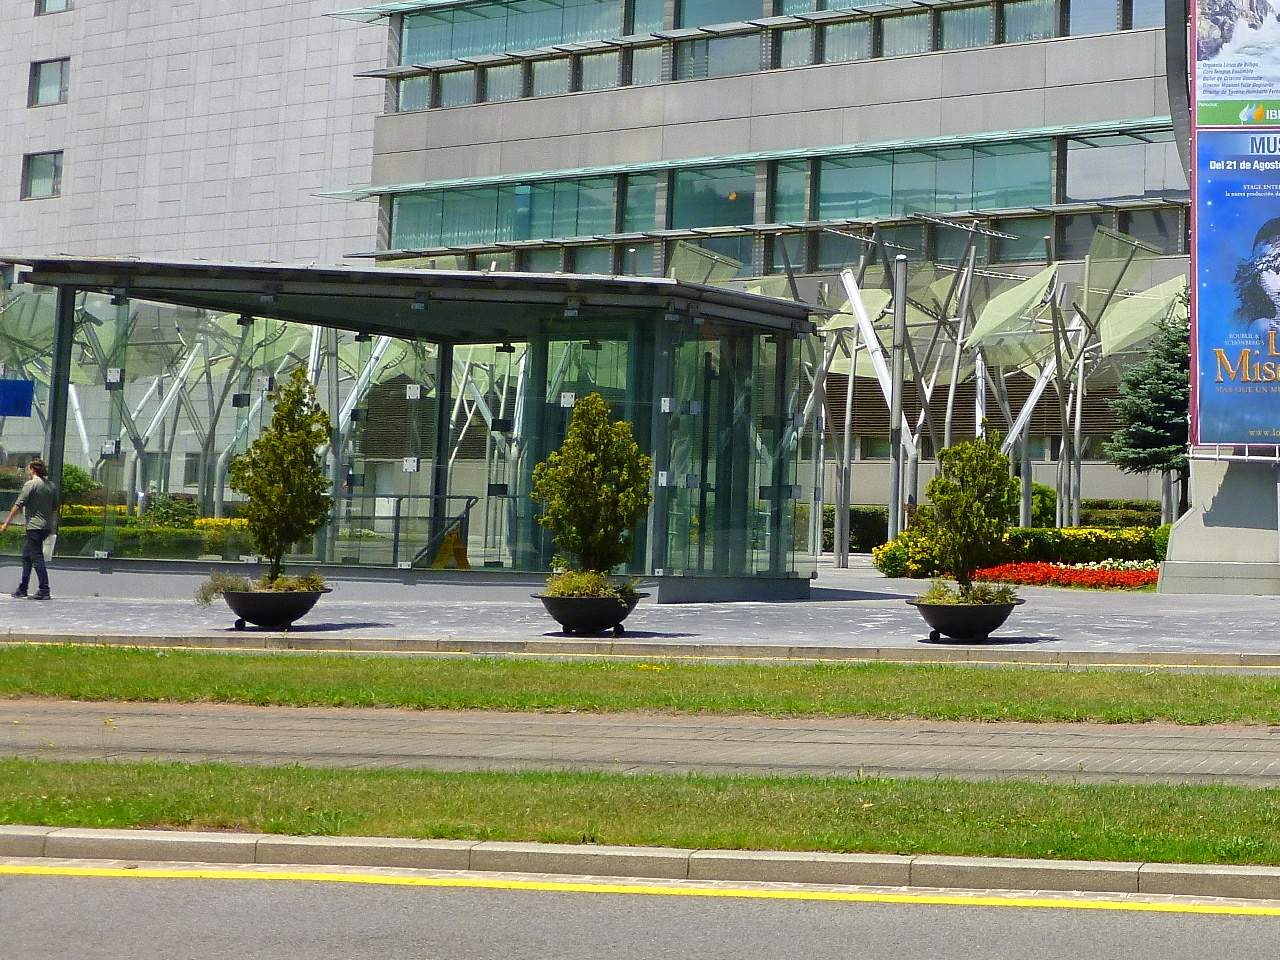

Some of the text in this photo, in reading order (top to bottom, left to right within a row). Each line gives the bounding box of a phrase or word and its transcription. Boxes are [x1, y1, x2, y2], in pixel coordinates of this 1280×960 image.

[1209, 160, 1225, 170] Del
[1226, 161, 1237, 170] 21
[1240, 160, 1251, 170] de
